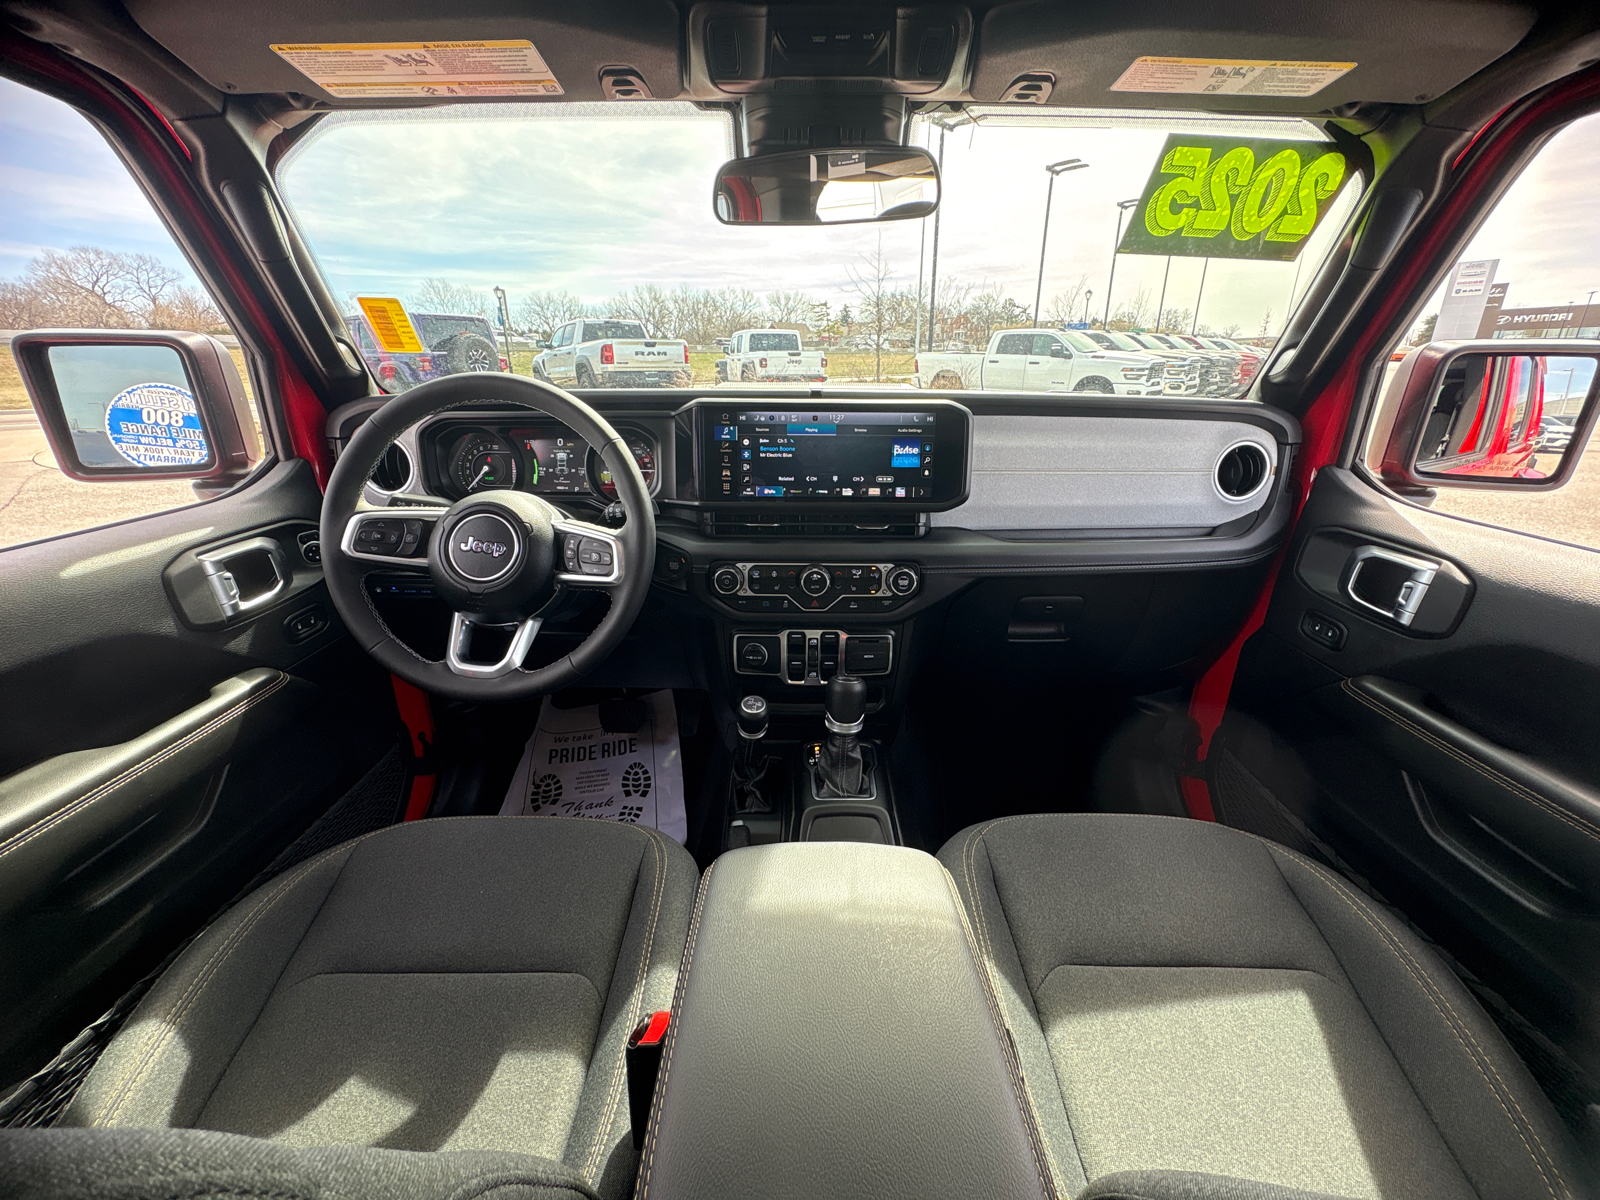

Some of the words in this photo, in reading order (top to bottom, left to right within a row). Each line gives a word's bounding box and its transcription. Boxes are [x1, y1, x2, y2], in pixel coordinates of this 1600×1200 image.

[1512, 312, 1574, 324] HYUNDAI
[557, 438, 564, 447] 0
[460, 536, 507, 557] Jeep
[554, 735, 570, 743] We
[572, 733, 594, 742] take
[548, 744, 597, 765] PRIDE
[601, 738, 638, 759] RIDE
[561, 796, 614, 814] Thank
